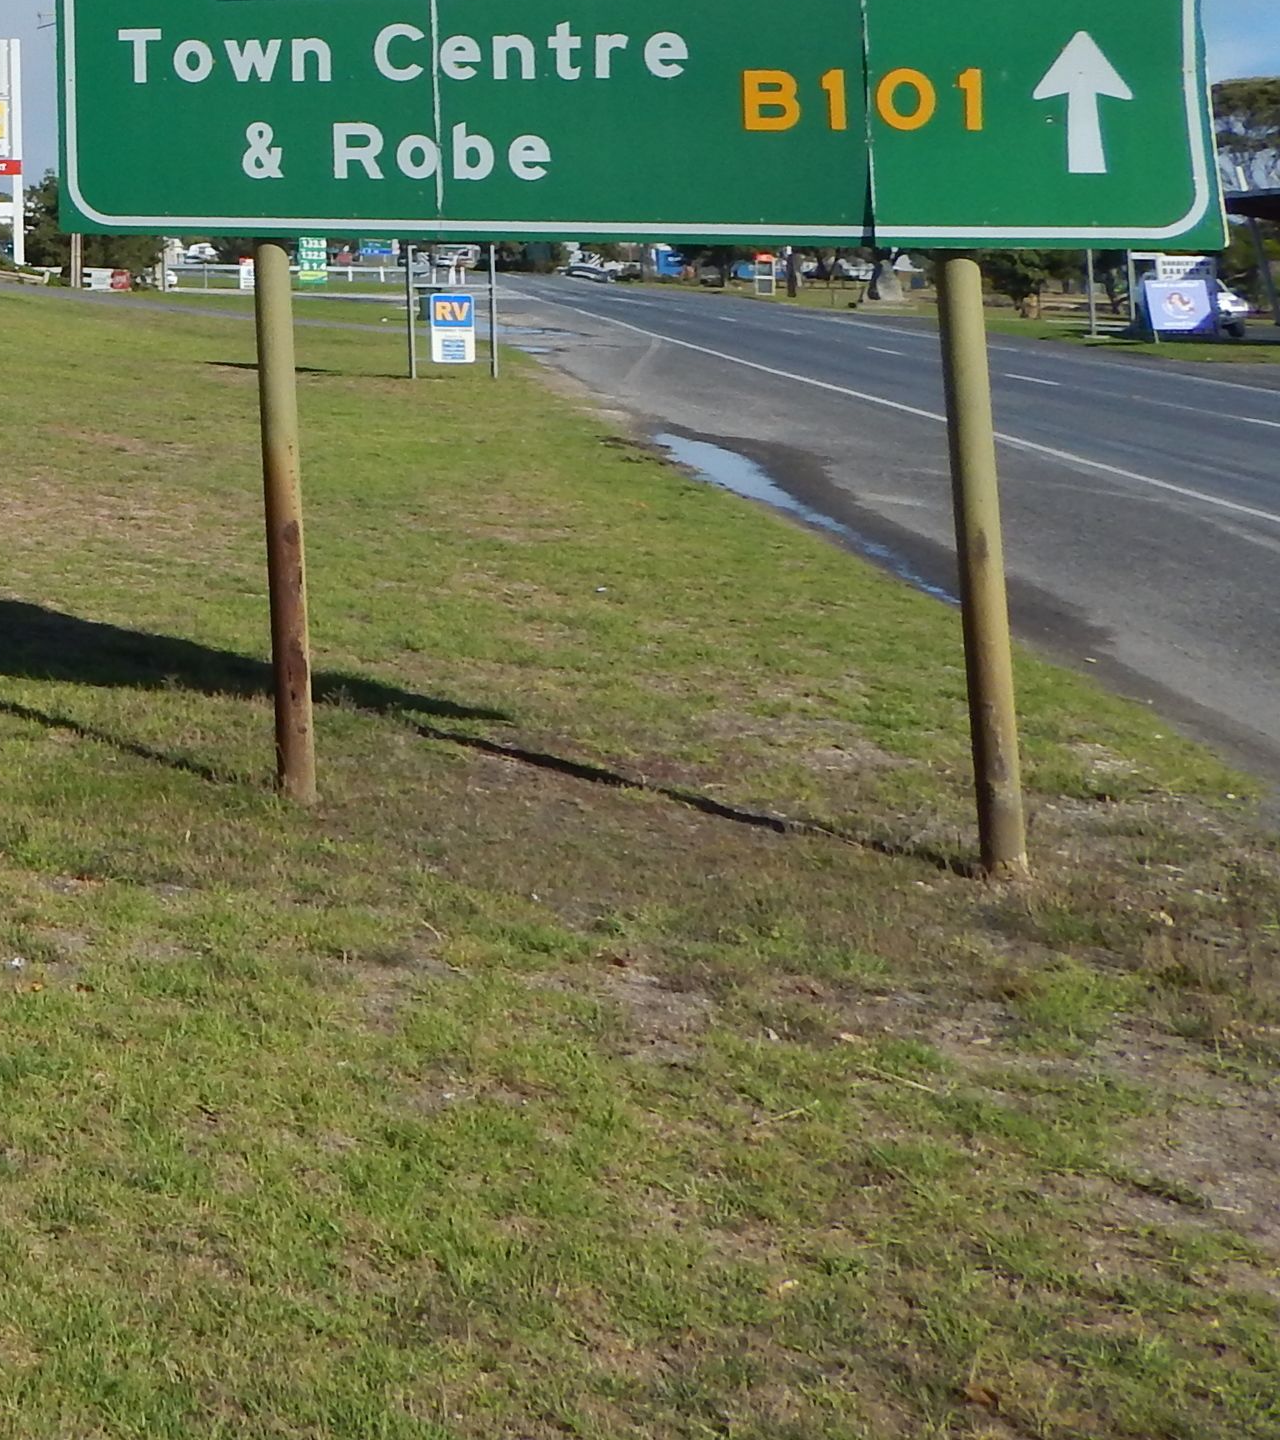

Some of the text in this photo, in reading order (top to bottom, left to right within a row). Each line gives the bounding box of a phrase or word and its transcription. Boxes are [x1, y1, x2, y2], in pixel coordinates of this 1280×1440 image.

[118, 22, 689, 84] Town Centre
[743, 68, 983, 131] B101
[241, 121, 551, 181] & Robe
[435, 301, 470, 321] RV
